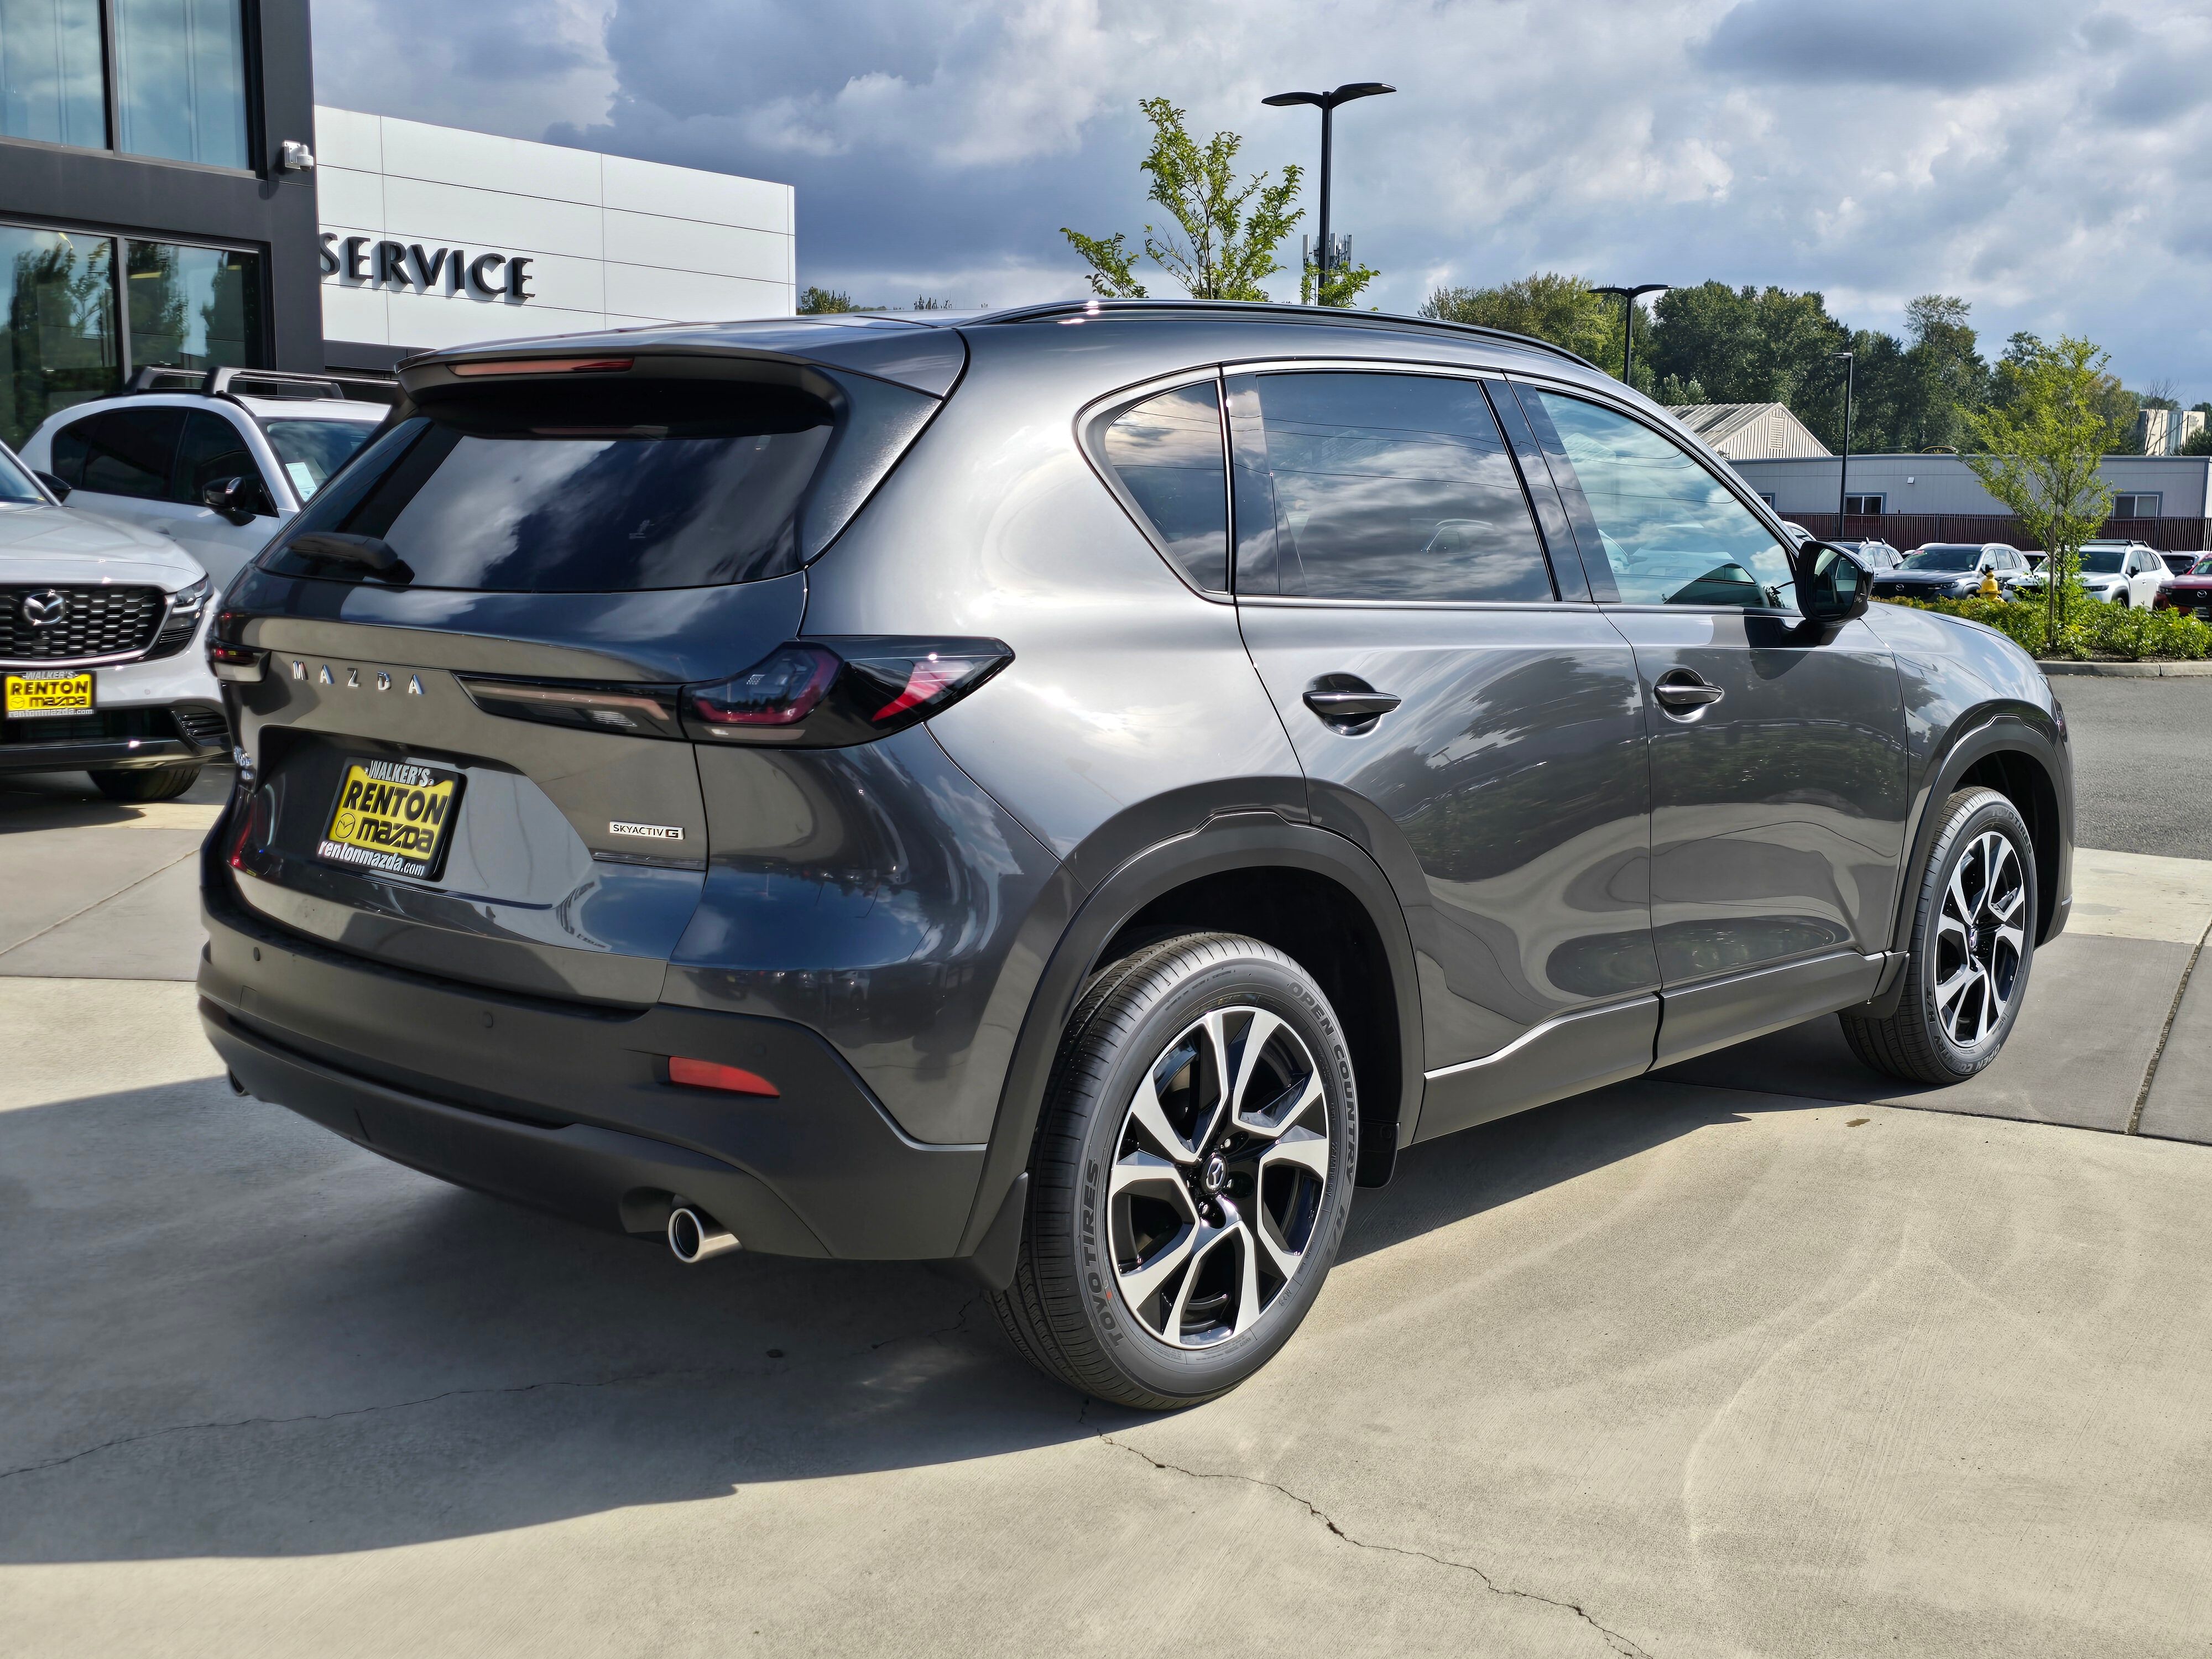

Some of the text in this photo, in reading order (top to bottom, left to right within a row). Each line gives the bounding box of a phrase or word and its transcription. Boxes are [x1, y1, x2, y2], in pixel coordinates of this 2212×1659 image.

[320, 232, 535, 298] SERVICE
[11, 681, 88, 695] RENTON
[25, 671, 76, 680] WALKER'S
[293, 660, 425, 695] MAZDA
[29, 696, 87, 707] mazda
[369, 760, 431, 787] WALKER'S
[342, 779, 448, 826] RENTON
[356, 816, 435, 854] mazda
[318, 841, 425, 877] rentonmazda.com
[1975, 1043, 2001, 1071] OPEN
[1287, 982, 1334, 1036] OPEN
[1333, 1044, 1355, 1186] COUNTRY
